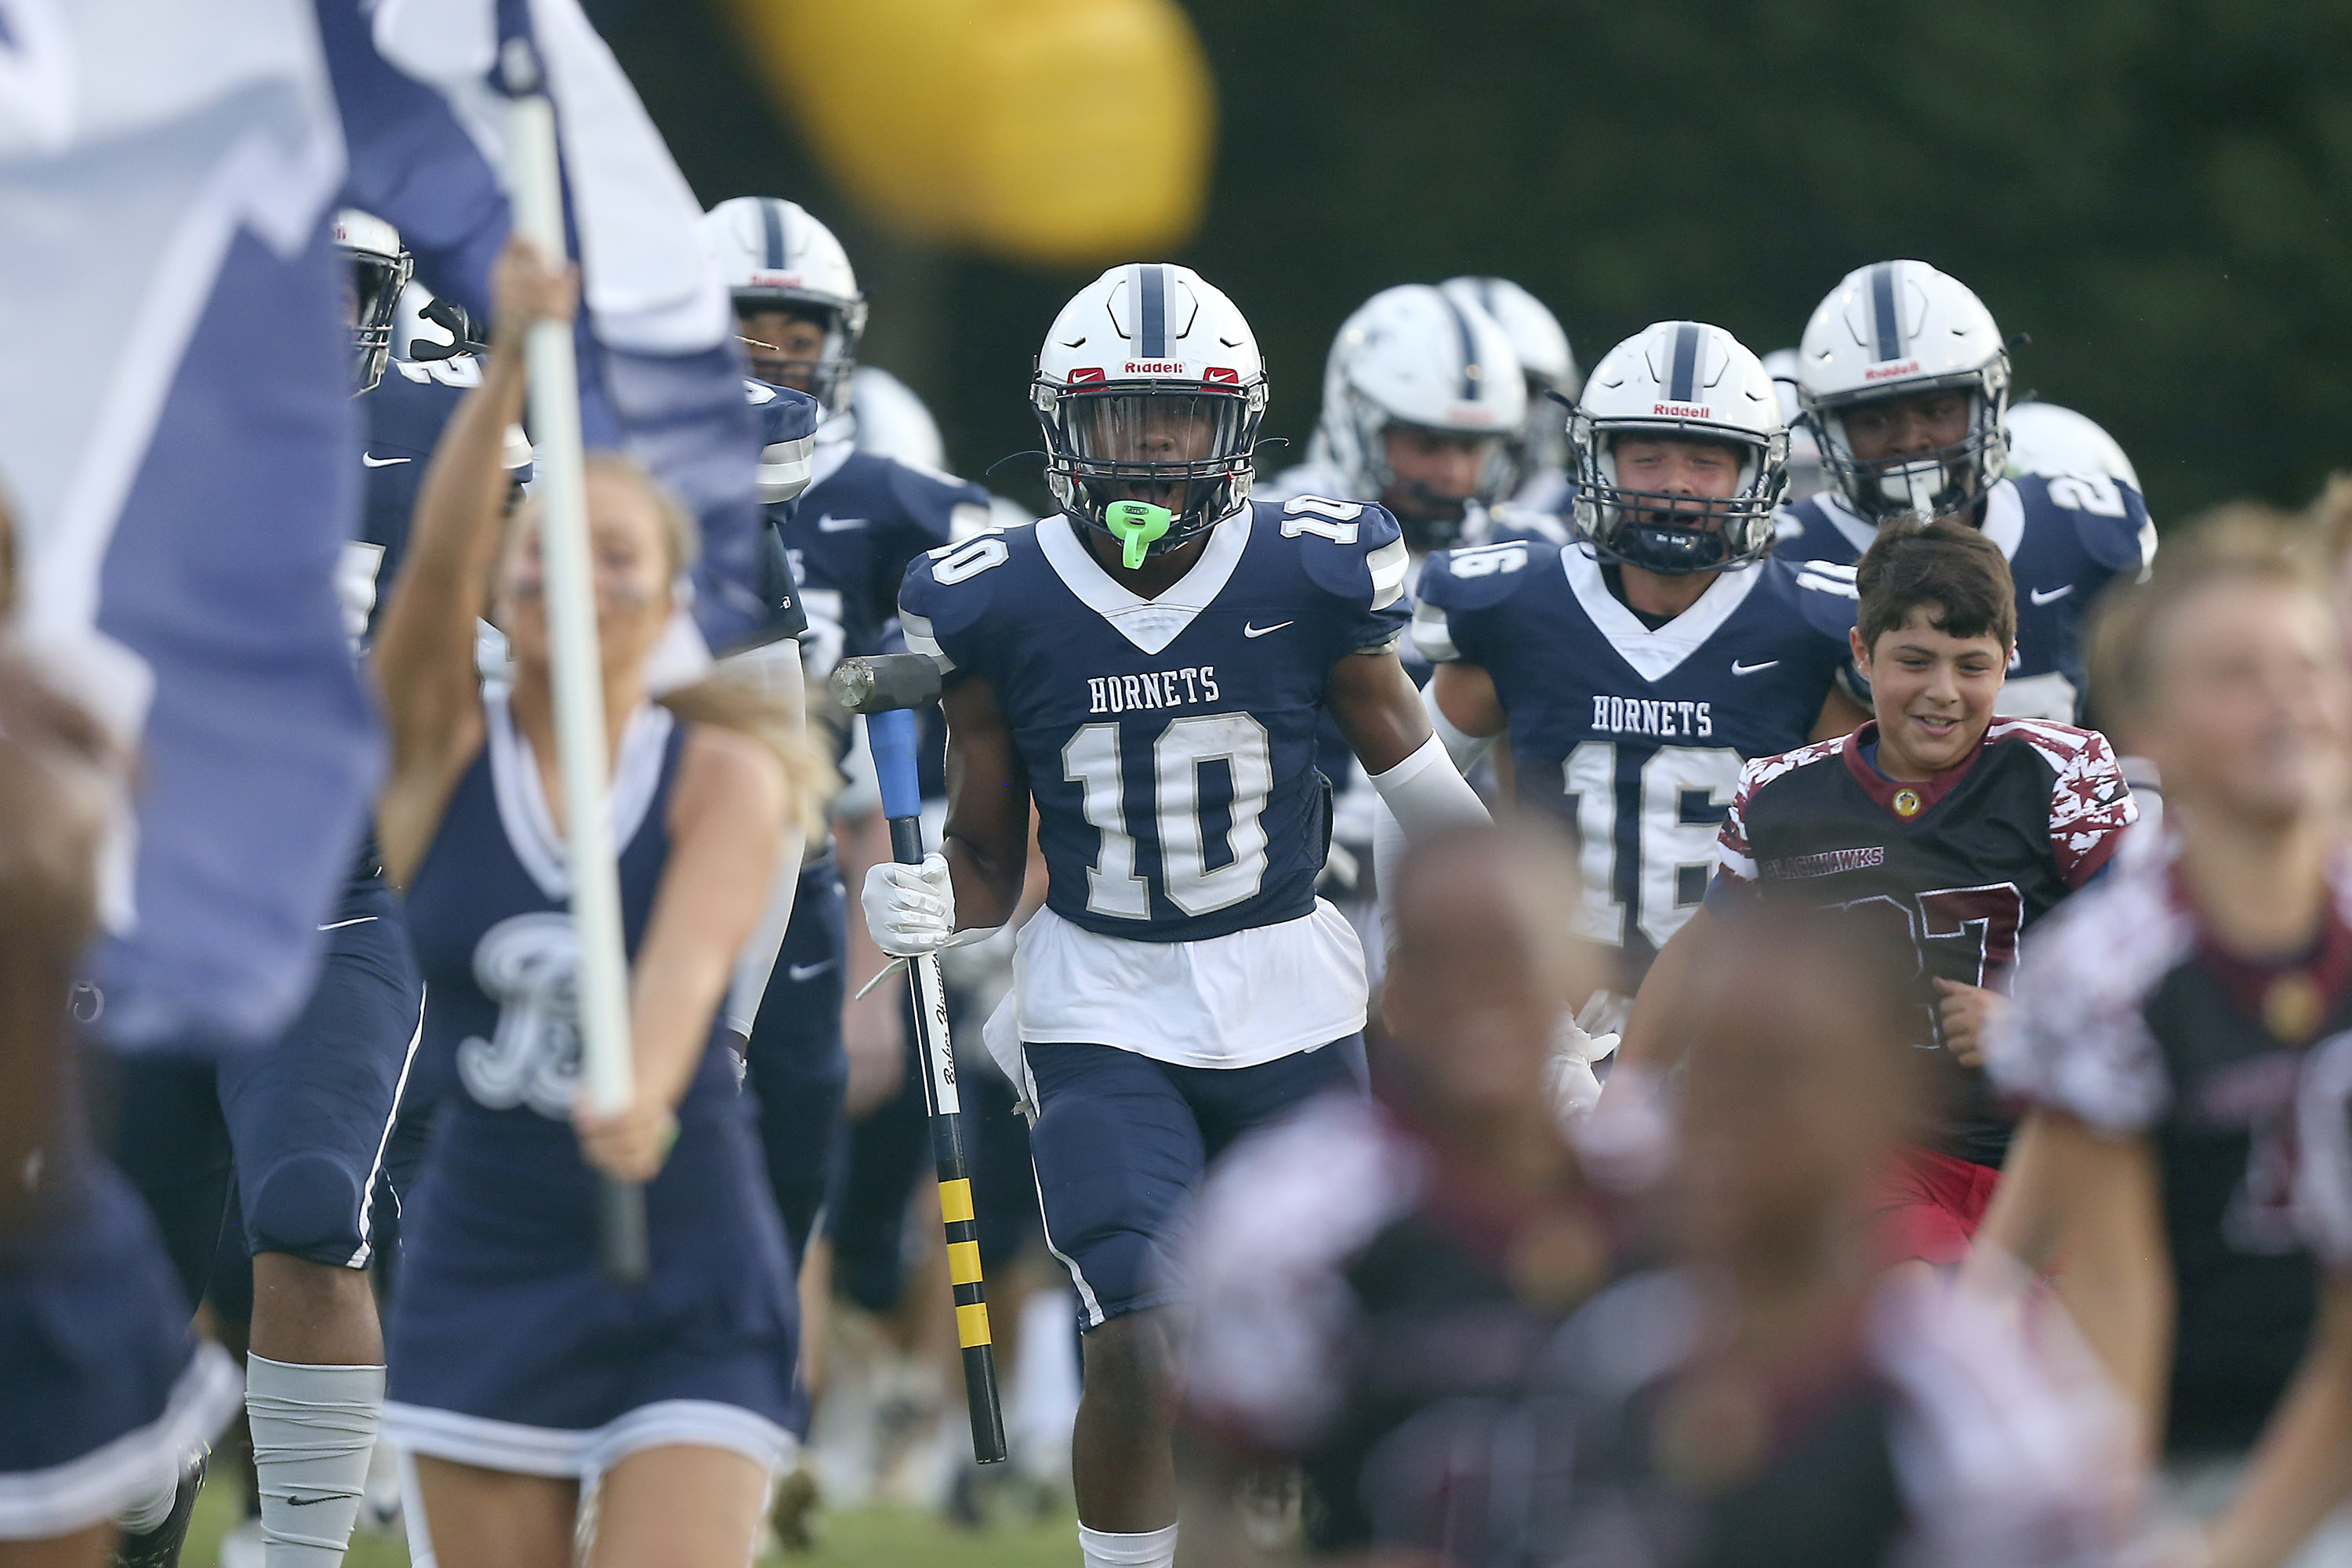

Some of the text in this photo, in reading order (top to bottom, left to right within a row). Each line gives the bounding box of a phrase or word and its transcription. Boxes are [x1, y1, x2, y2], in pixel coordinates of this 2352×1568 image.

[1125, 362, 1182, 373] Riddell
[1654, 404, 1709, 418] Riddell
[1279, 494, 1364, 544] 10
[926, 527, 1010, 586] 10
[1087, 666, 1220, 713] HORNETS
[1591, 695, 1713, 737] HORNETS
[1061, 711, 1273, 920] 10
[1562, 740, 1750, 950] 16
